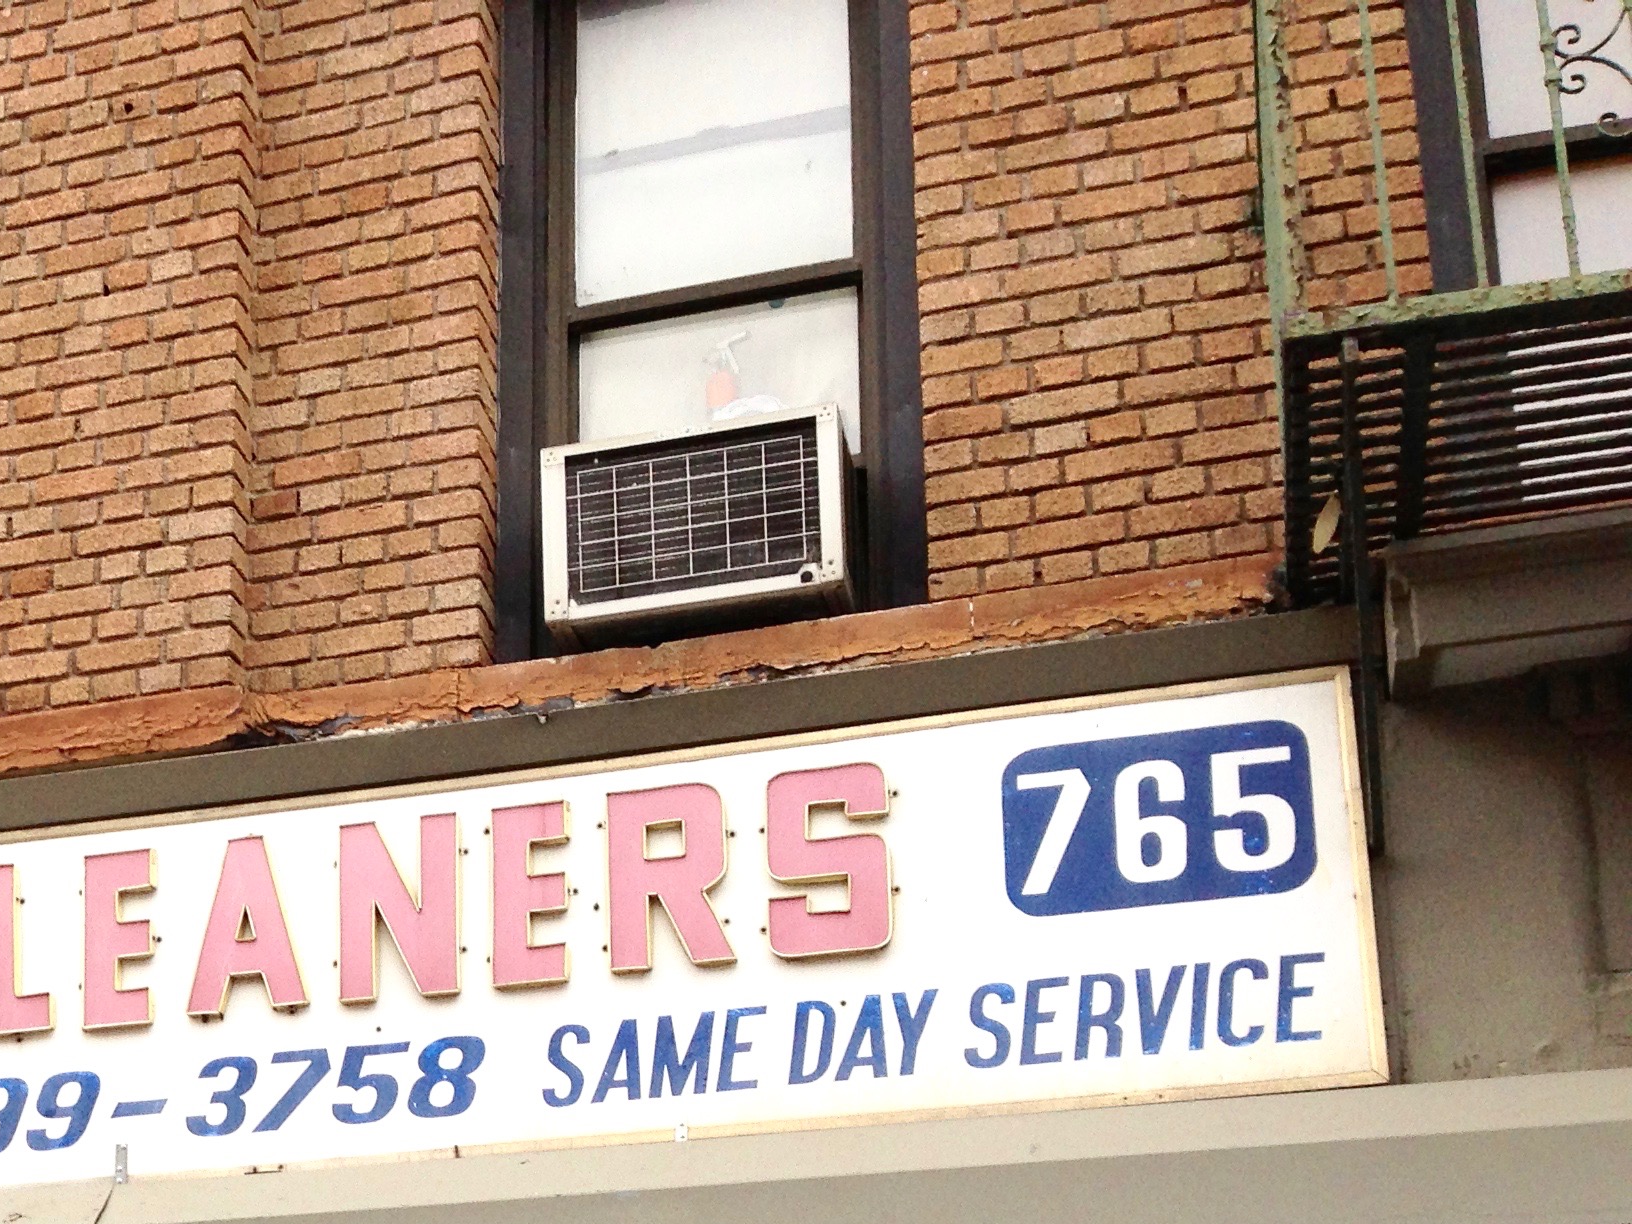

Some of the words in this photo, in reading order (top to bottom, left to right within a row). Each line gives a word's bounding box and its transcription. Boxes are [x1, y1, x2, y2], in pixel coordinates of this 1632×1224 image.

[1016, 745, 1297, 897] 765
[543, 1002, 768, 1109] SAME
[788, 987, 940, 1087] DAY
[962, 951, 1326, 1070] SERVICE
